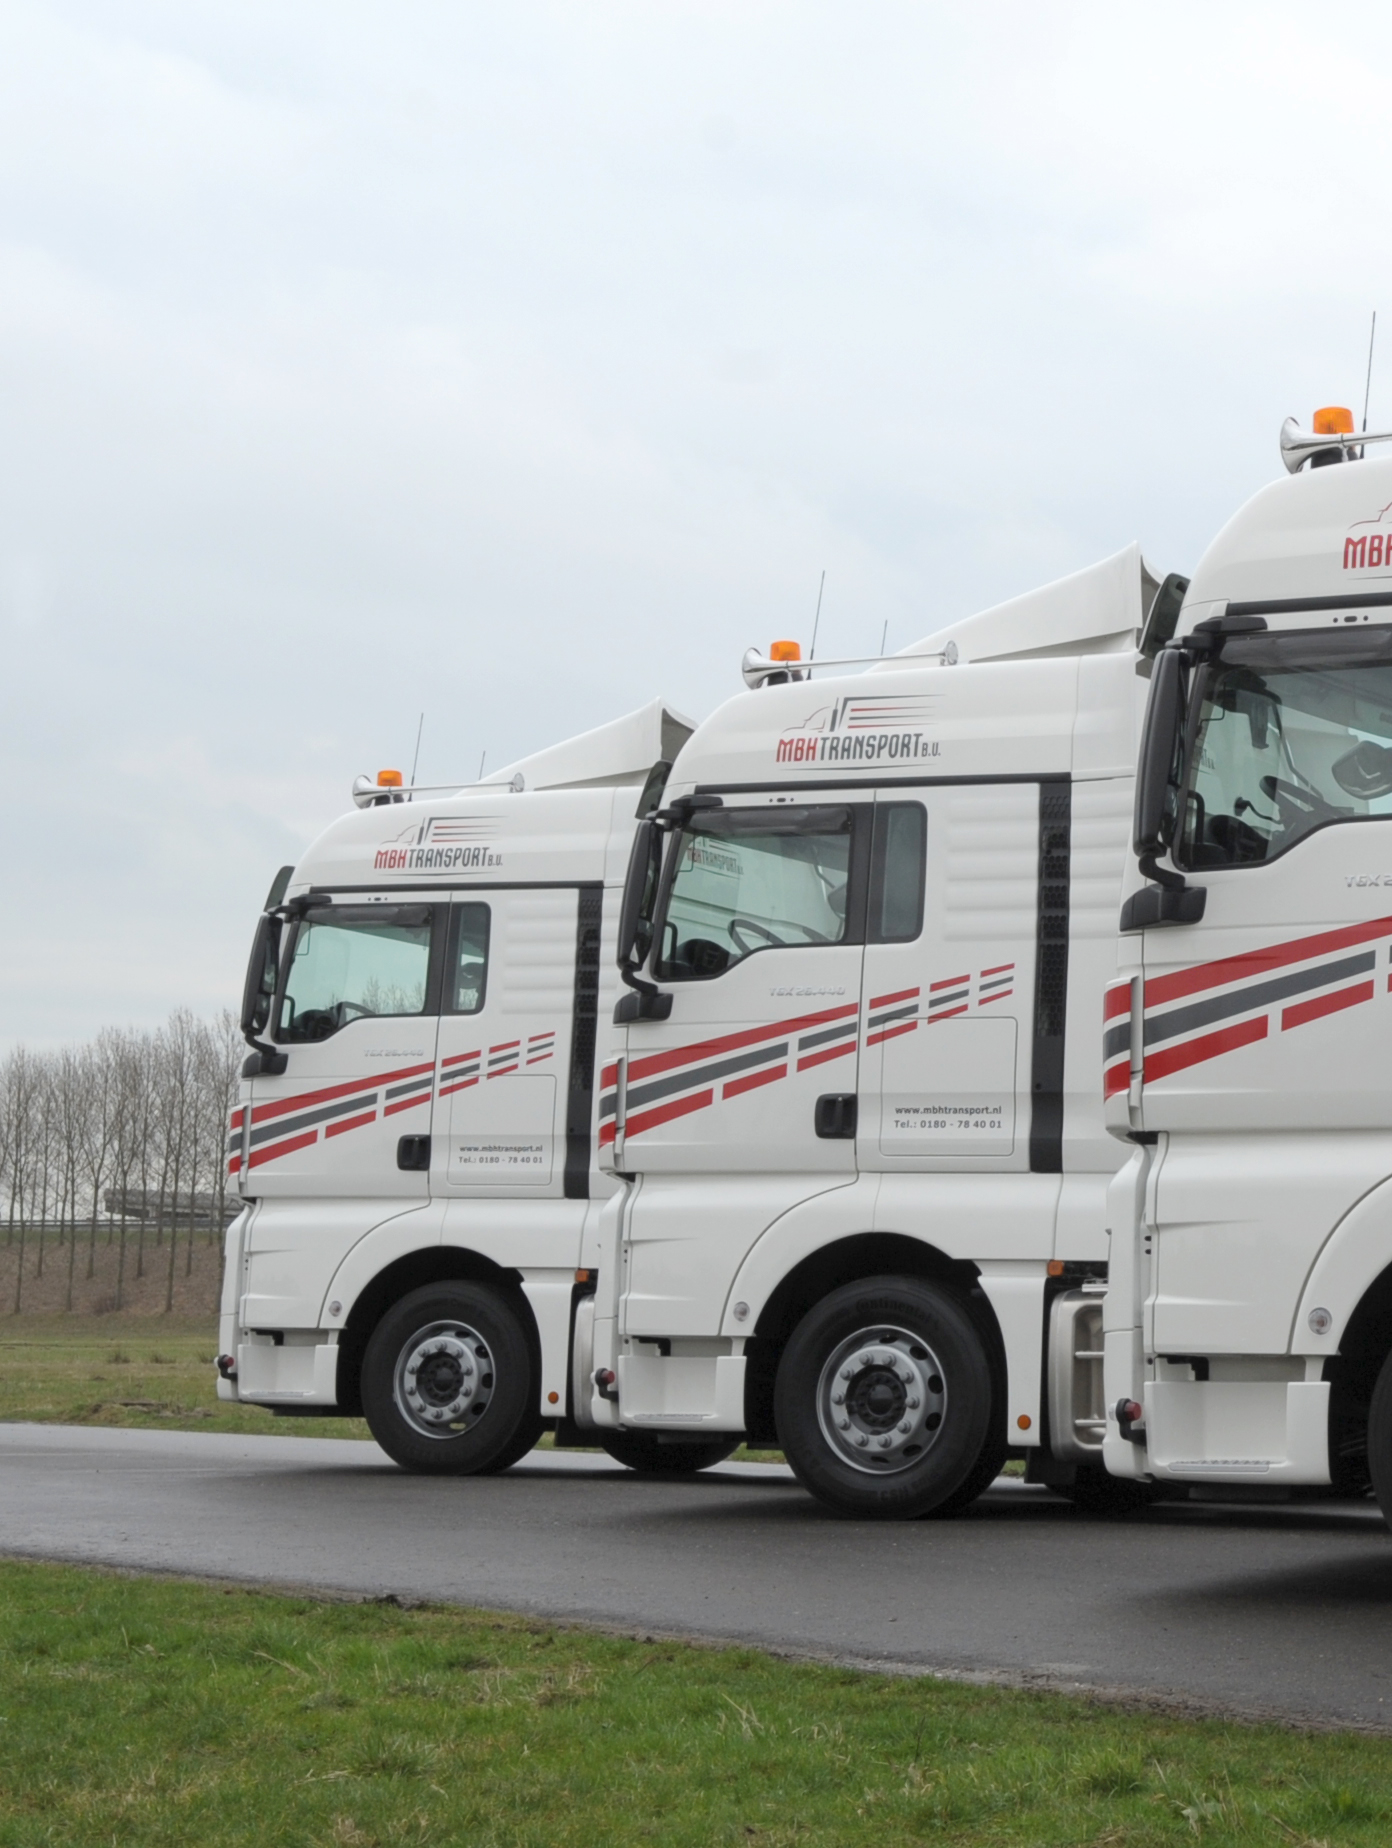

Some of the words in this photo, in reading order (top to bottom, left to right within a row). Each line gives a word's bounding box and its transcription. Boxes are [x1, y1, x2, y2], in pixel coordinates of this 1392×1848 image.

[894, 1105, 1002, 1116] www.mbhtransport.nl
[919, 1119, 947, 1129] 0180
[957, 1120, 970, 1129] 78
[972, 1120, 987, 1129] 40
[989, 1120, 1002, 1129] 01
